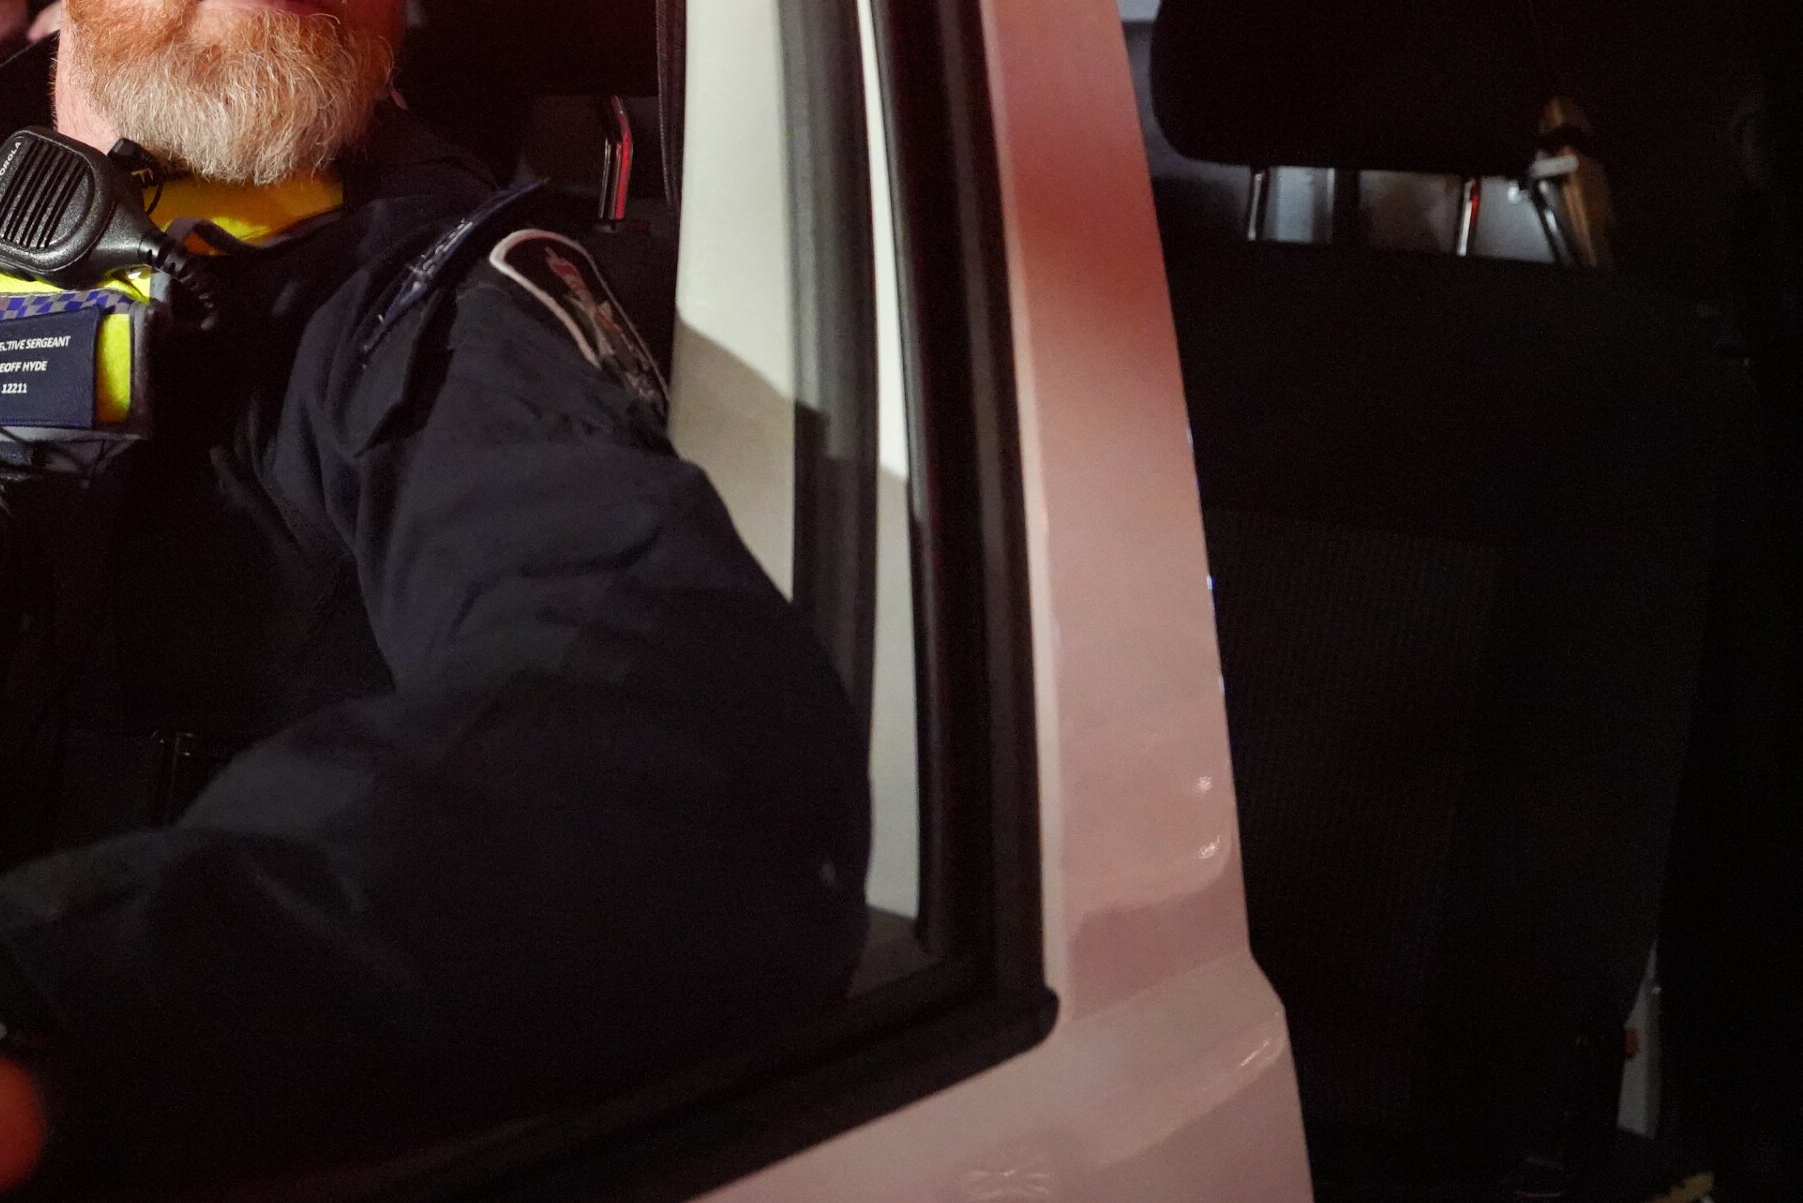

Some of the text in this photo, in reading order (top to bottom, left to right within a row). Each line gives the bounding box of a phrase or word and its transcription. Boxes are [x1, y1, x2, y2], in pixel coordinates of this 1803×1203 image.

[25, 335, 71, 349] SERGEANT
[22, 360, 48, 372] HYDE
[1, 382, 28, 394] 12211
